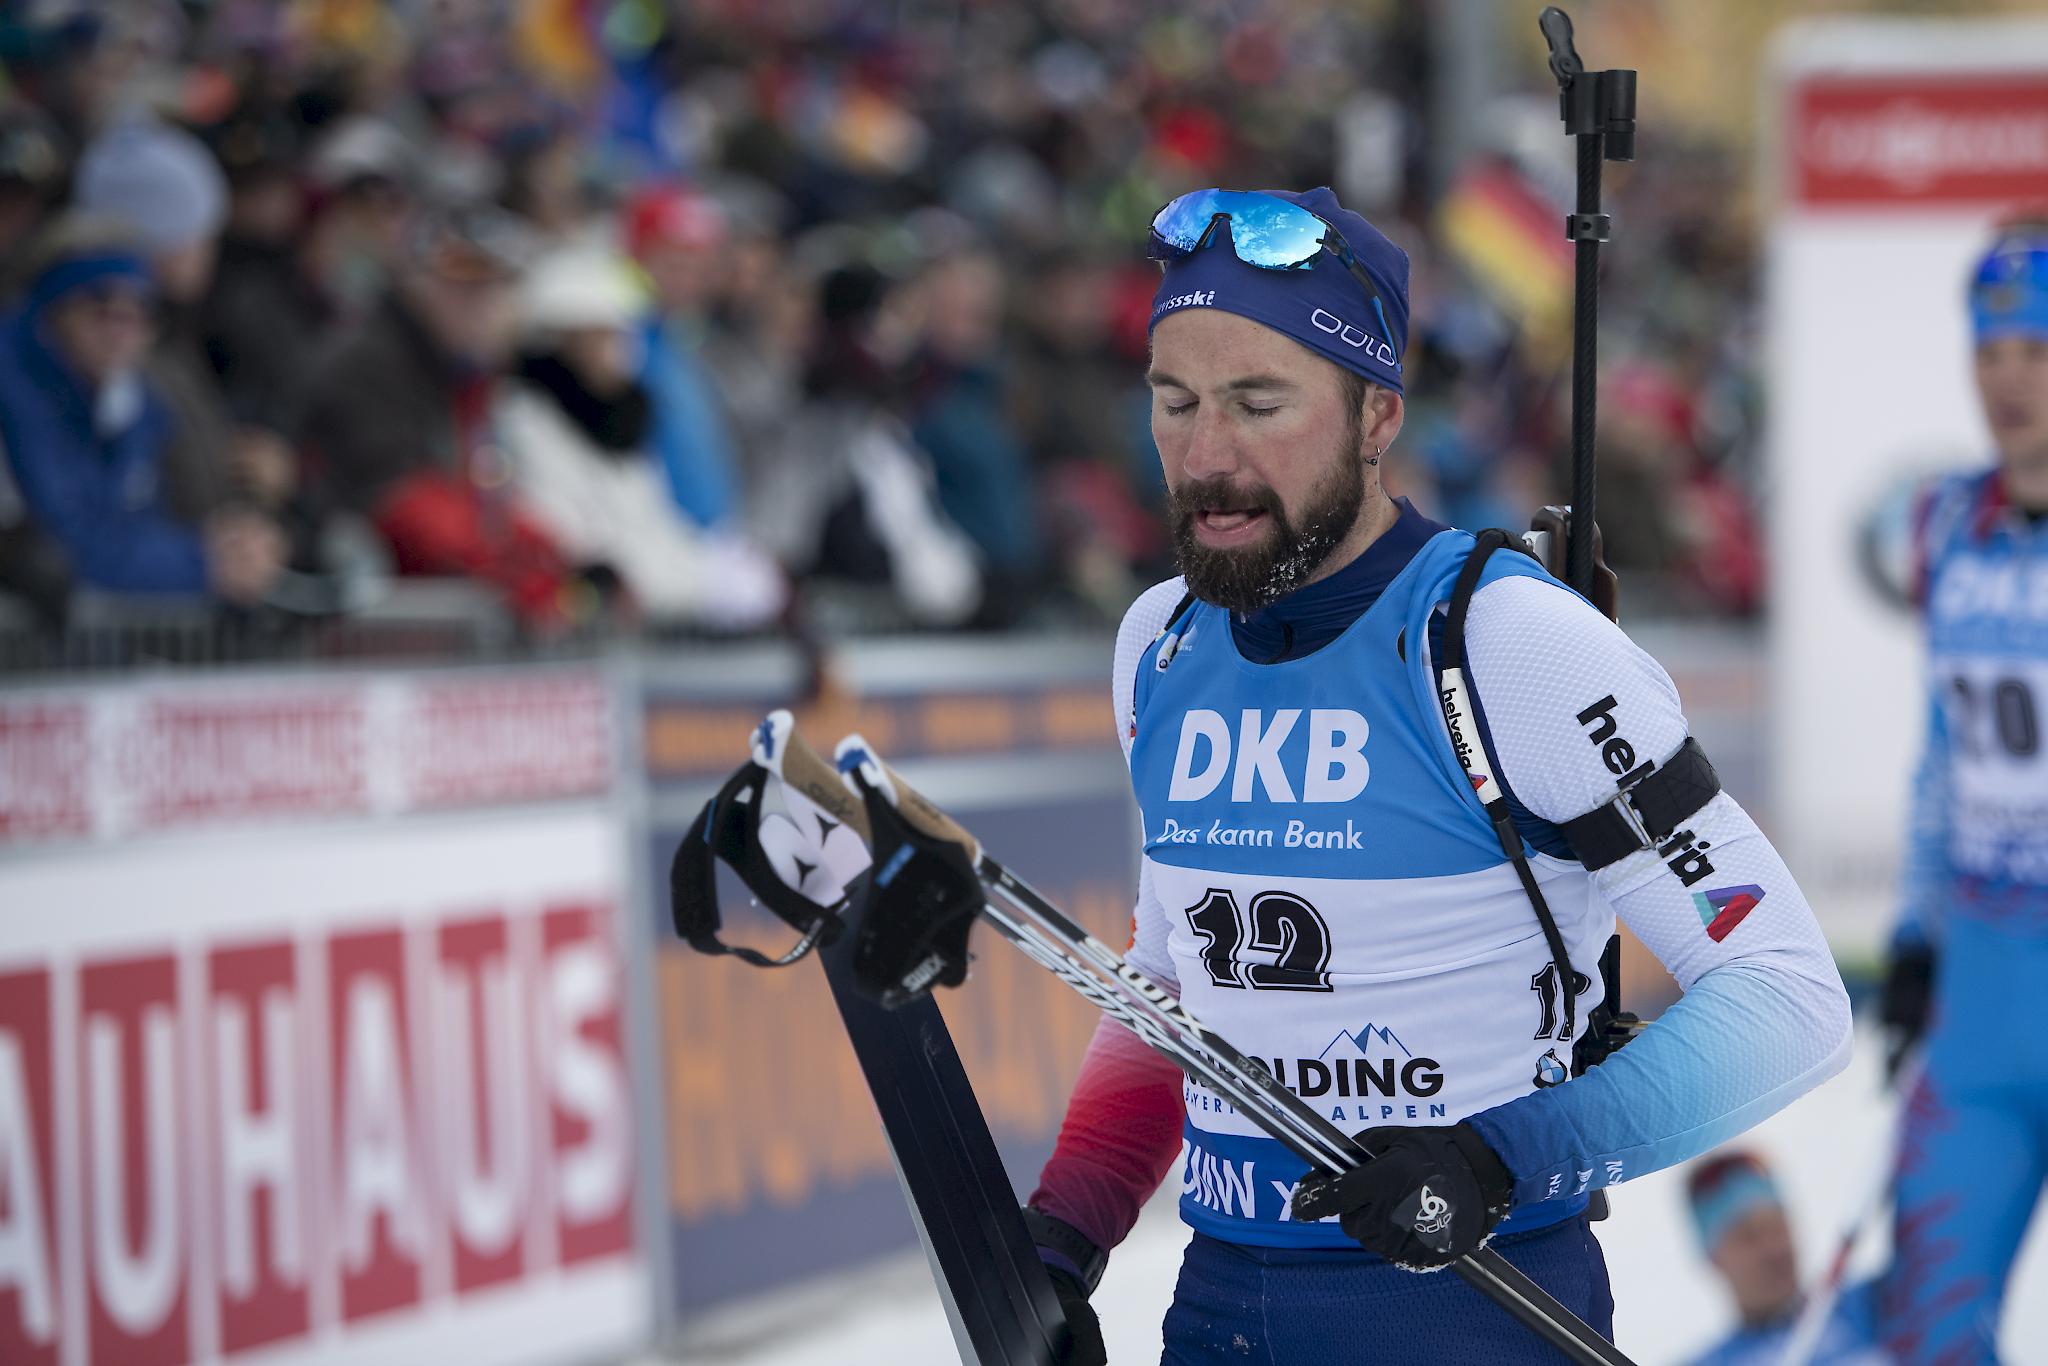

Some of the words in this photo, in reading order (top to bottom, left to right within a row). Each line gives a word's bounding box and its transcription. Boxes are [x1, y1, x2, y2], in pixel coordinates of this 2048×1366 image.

[1168, 708, 1371, 804] DKB
[1442, 688, 1473, 769] helvetia
[1156, 819, 1200, 845] Das
[1207, 819, 1274, 847] kann
[1284, 820, 1365, 850] Bank
[1576, 694, 1716, 888] heltia
[1185, 888, 1334, 992] 12
[1331, 1103, 1446, 1121] ALPEN
